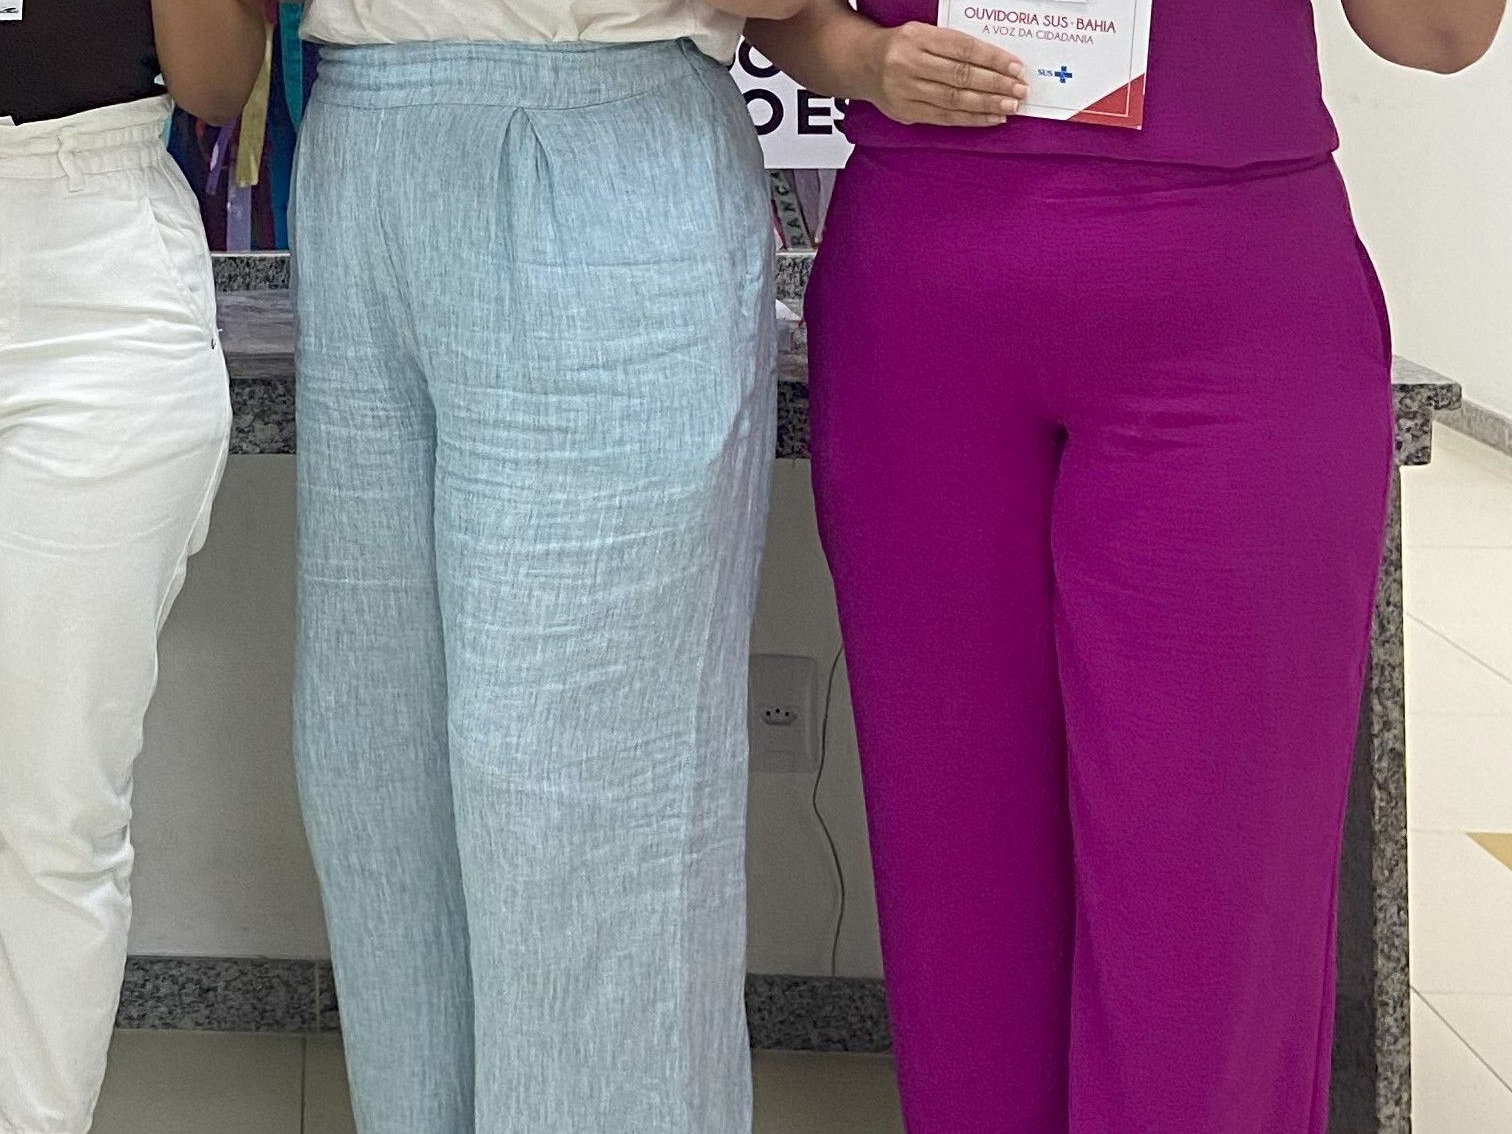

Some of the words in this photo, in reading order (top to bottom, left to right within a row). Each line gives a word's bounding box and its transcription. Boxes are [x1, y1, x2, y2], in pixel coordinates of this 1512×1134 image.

[964, 6, 1039, 26] OUVIDORIA
[1043, 15, 1069, 29] SUS
[1076, 18, 1116, 34] BAHIA
[982, 25, 990, 34] A
[992, 26, 1016, 37] VOZ
[1018, 28, 1034, 39] DA
[1035, 30, 1094, 45] CIDADANIA
